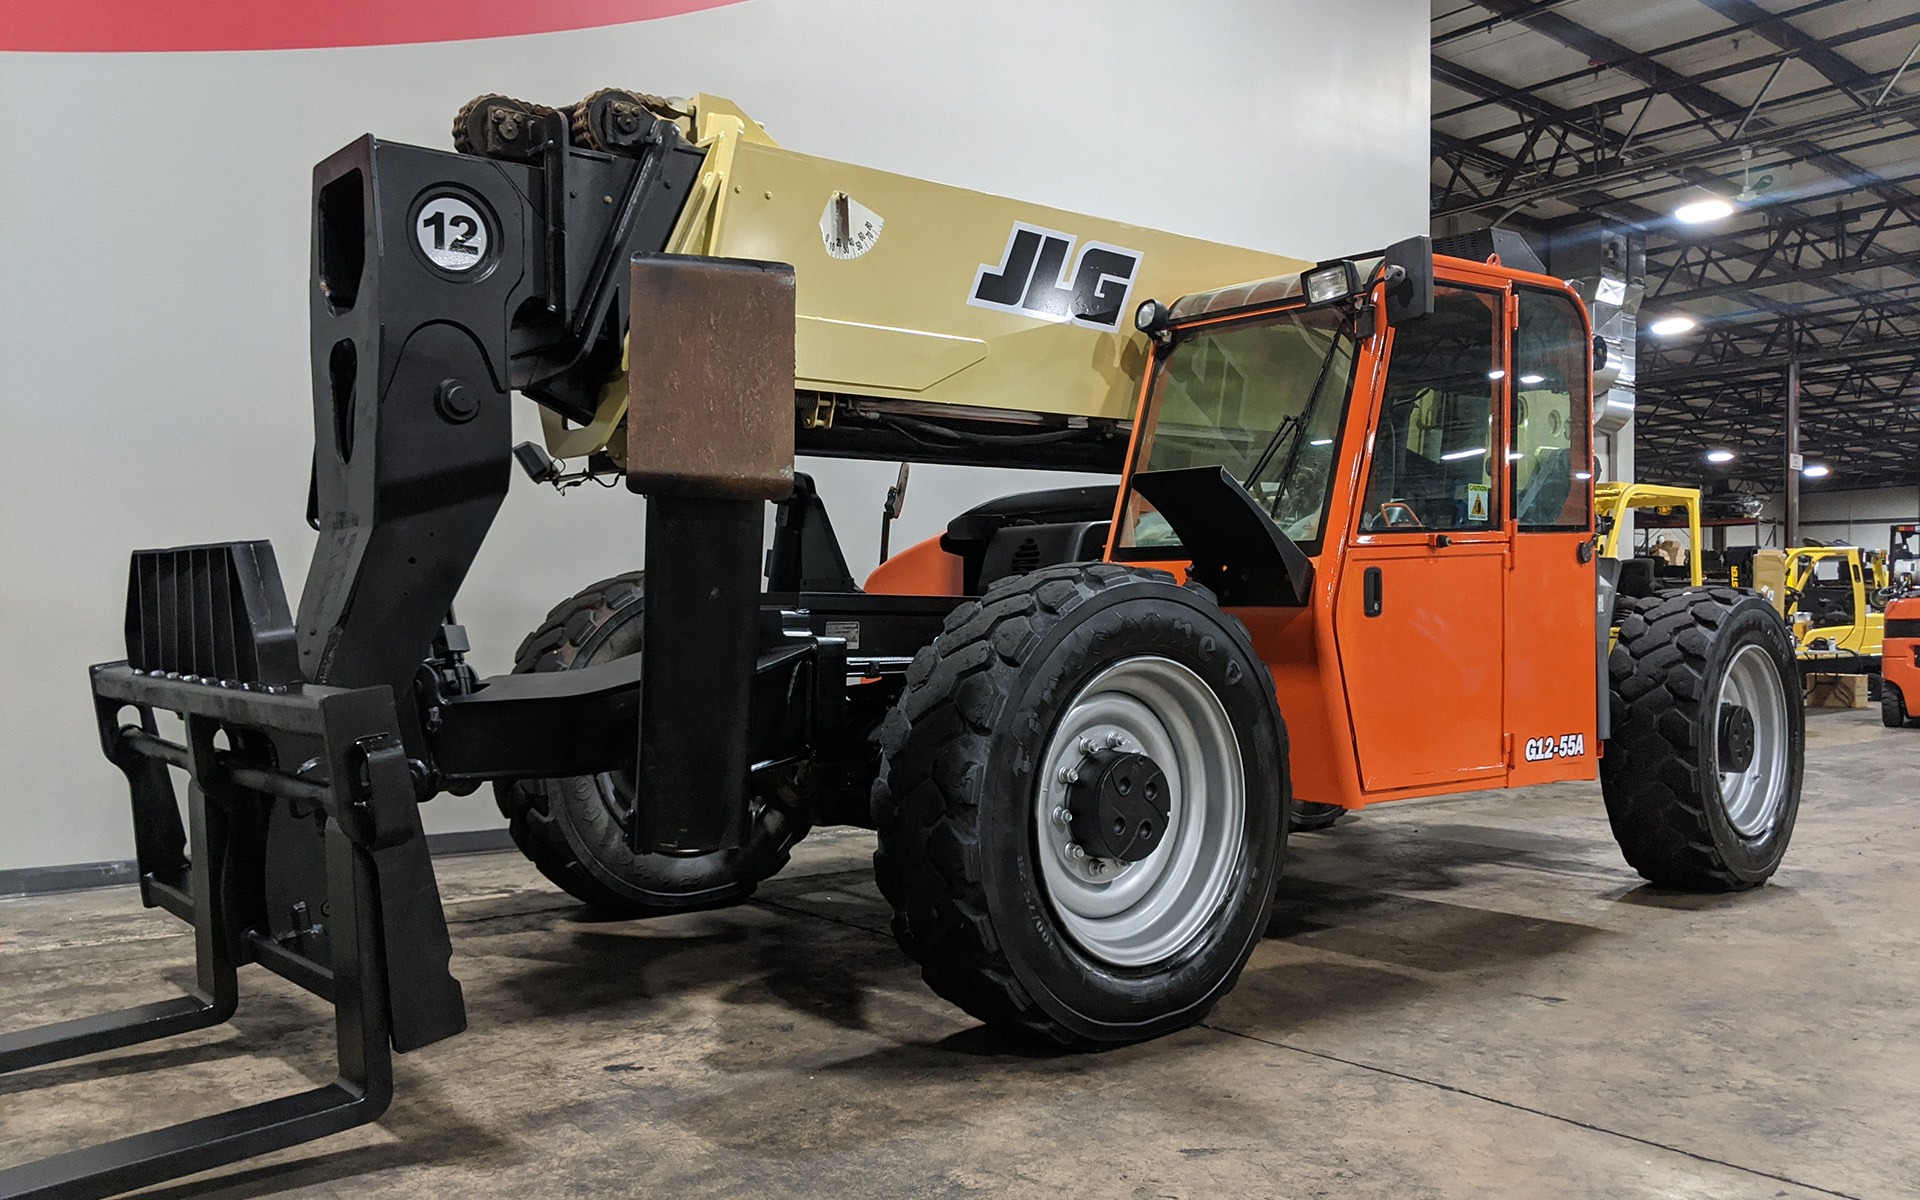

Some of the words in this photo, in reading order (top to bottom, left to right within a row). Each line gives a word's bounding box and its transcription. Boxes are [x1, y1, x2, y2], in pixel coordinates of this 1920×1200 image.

[865, 221, 873, 231] 80
[423, 211, 479, 255] 12
[865, 231, 873, 241] 70
[855, 240, 863, 251] 50
[971, 226, 1140, 329] JLG
[1469, 484, 1488, 492] CAUTION
[1525, 733, 1584, 762] G12-55A
